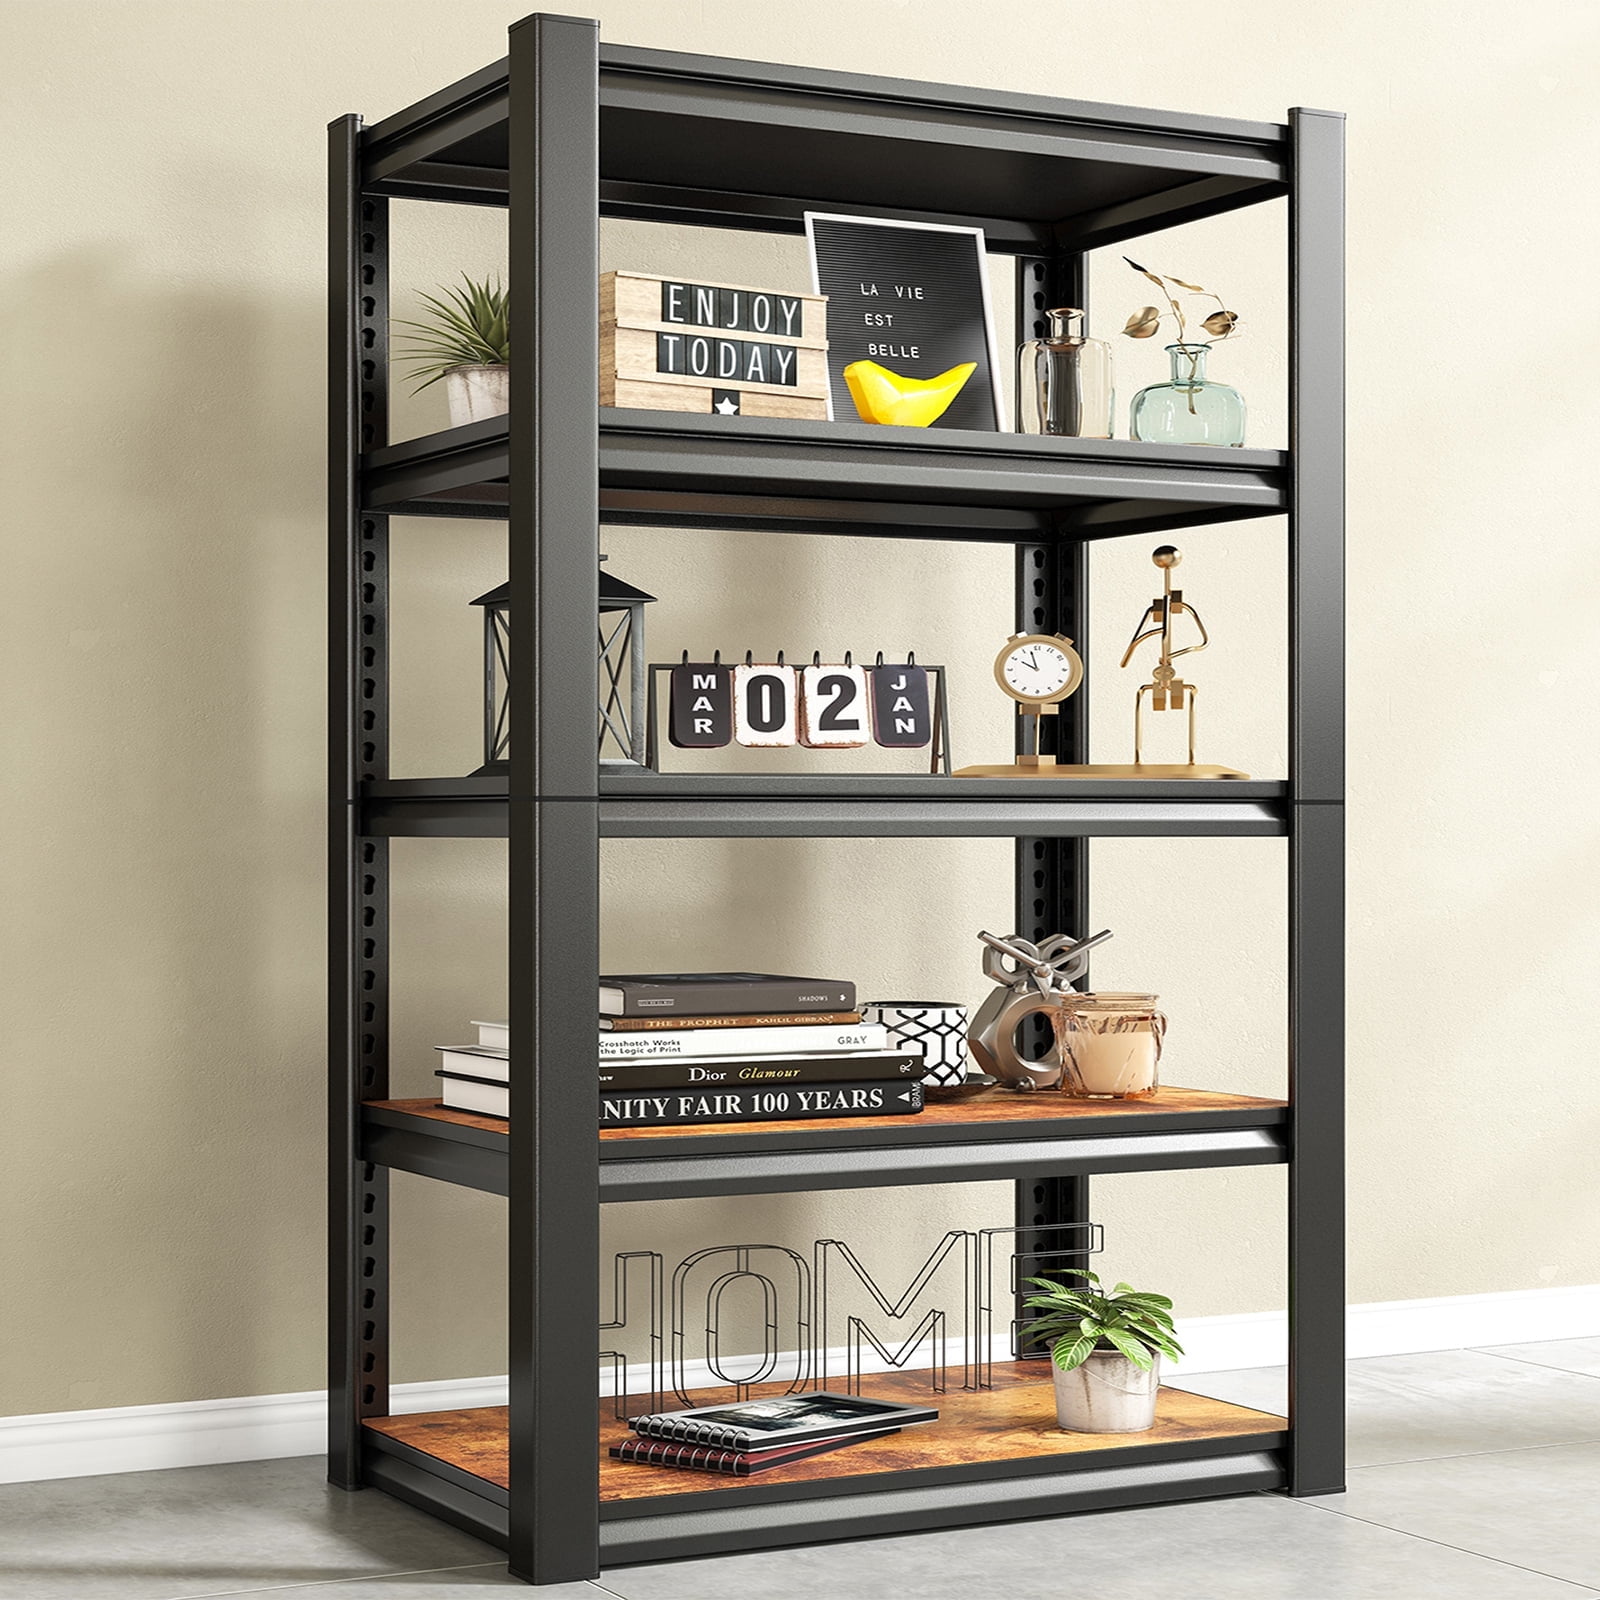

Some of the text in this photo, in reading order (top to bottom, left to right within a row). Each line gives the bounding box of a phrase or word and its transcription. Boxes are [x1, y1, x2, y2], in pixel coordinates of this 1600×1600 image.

[860, 283, 924, 300] LA VIE
[669, 284, 798, 336] ENJOY
[864, 313, 893, 327] EST
[868, 343, 920, 359] BELLE
[662, 335, 793, 385] TODAY
[692, 673, 717, 734] MAR
[890, 674, 917, 735] JAN
[680, 1018, 739, 1026] PROPHET
[837, 1036, 868, 1045] GRAY
[620, 1047, 645, 1055] Logic
[688, 1067, 801, 1082] Dior Glamour
[599, 1088, 884, 1120] NITY FAIR 100 YEARS
